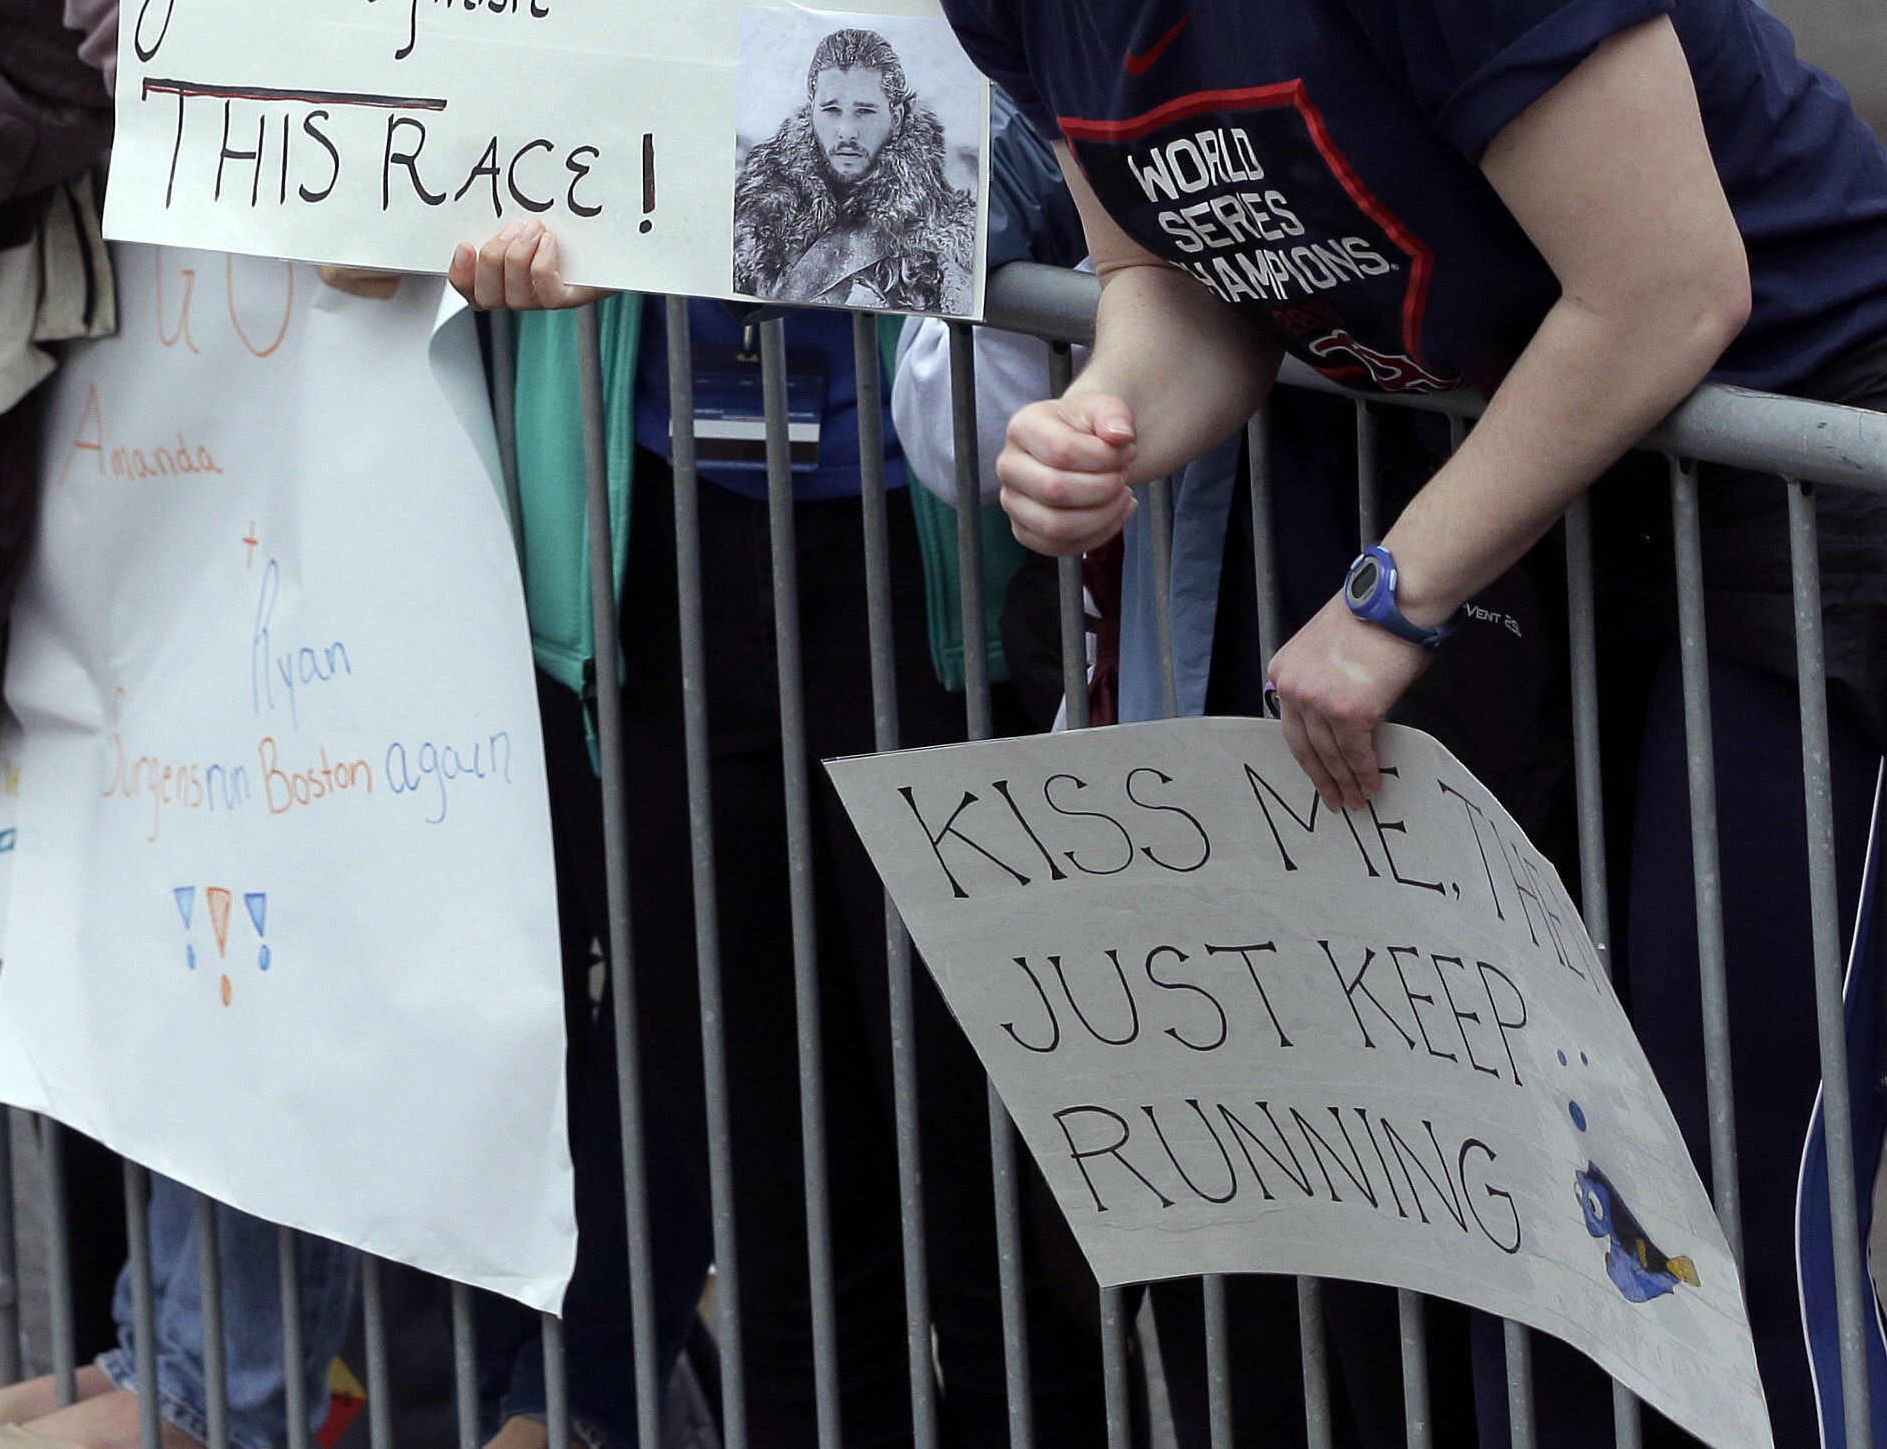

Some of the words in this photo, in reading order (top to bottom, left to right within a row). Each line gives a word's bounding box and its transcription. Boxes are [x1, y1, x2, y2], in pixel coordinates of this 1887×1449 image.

[141, 77, 343, 210] THIS
[1127, 127, 1265, 203] WORLD
[1168, 235, 1391, 304] HAMPIONS
[58, 384, 225, 487] Amanda
[251, 558, 354, 731] Ryan
[258, 737, 374, 816] Boston
[384, 731, 514, 826] again
[896, 767, 1212, 899] KISS
[1000, 940, 1294, 1052] JUST
[1316, 937, 1529, 1087] KEEP
[1051, 1097, 1524, 1255] RUNNING
